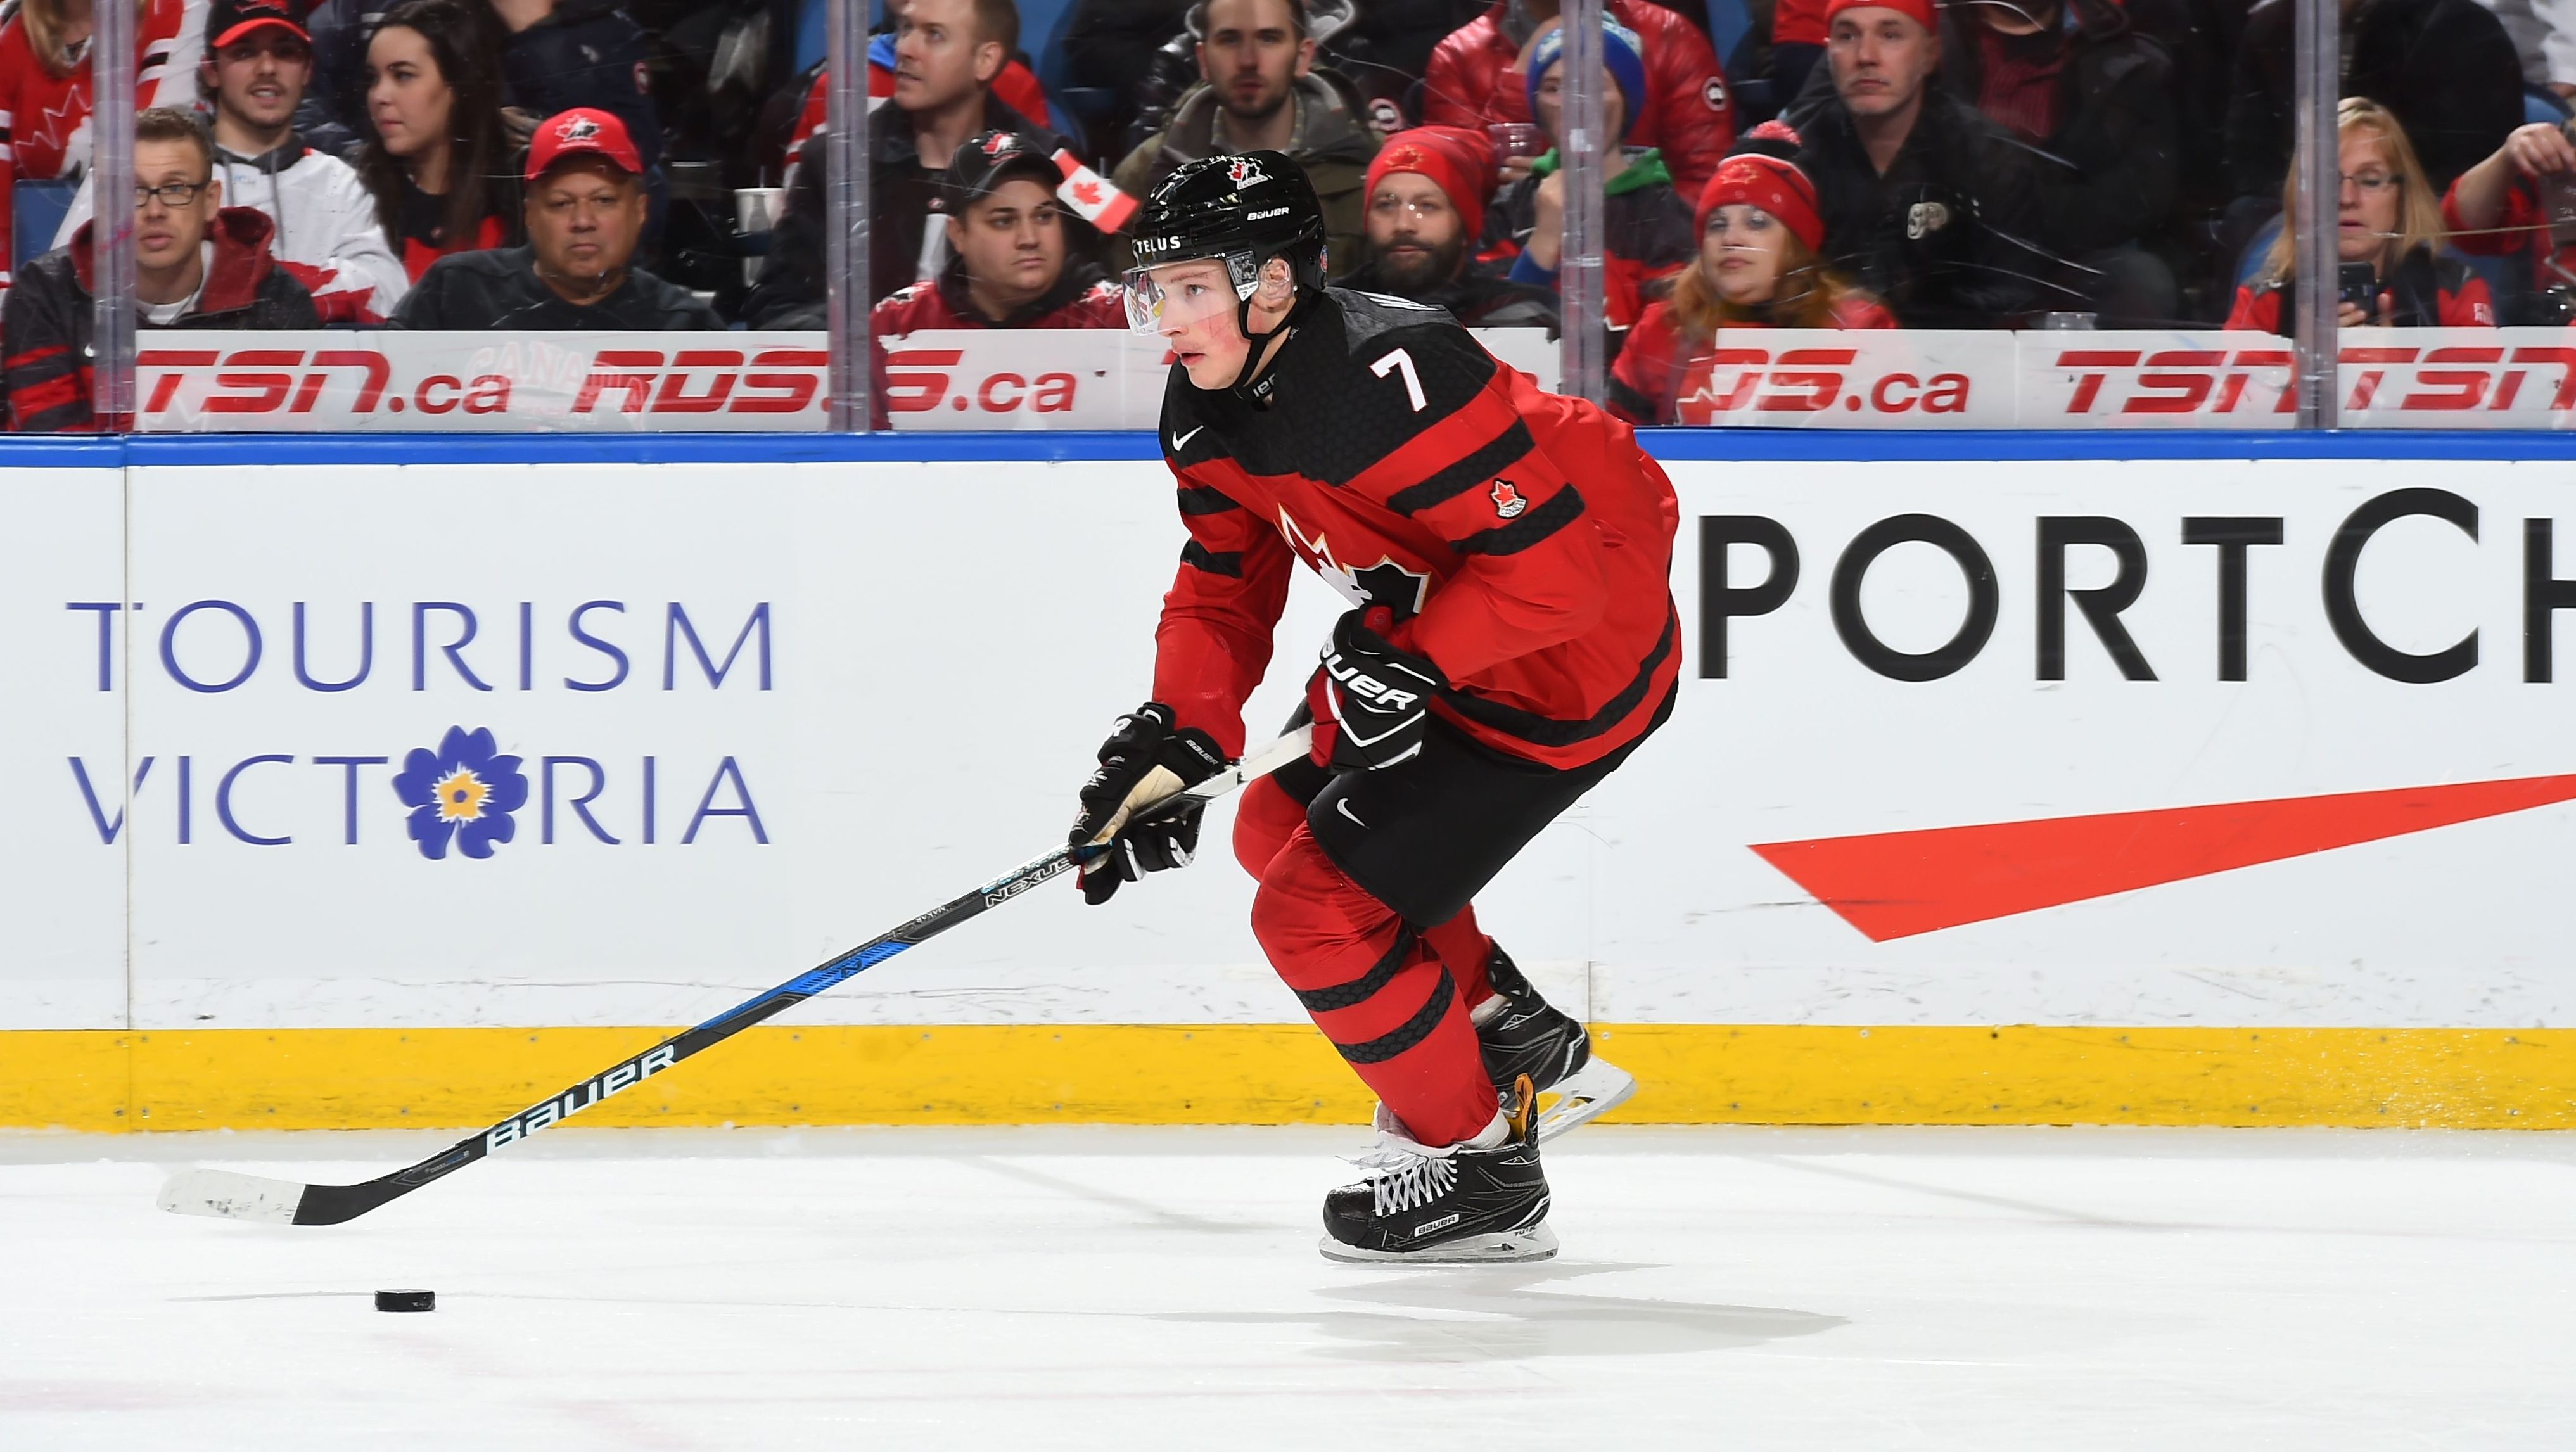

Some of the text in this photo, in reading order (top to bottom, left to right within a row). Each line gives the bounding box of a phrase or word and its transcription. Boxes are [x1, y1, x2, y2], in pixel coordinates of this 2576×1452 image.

[1137, 235, 1181, 254] TELUS
[137, 350, 511, 414] TSN.ca
[1369, 347, 1427, 412] 7
[2056, 350, 2297, 413] TSN
[2338, 347, 2576, 410] TSN
[67, 599, 772, 693] TOURISM
[984, 856, 1073, 908] NEXUS
